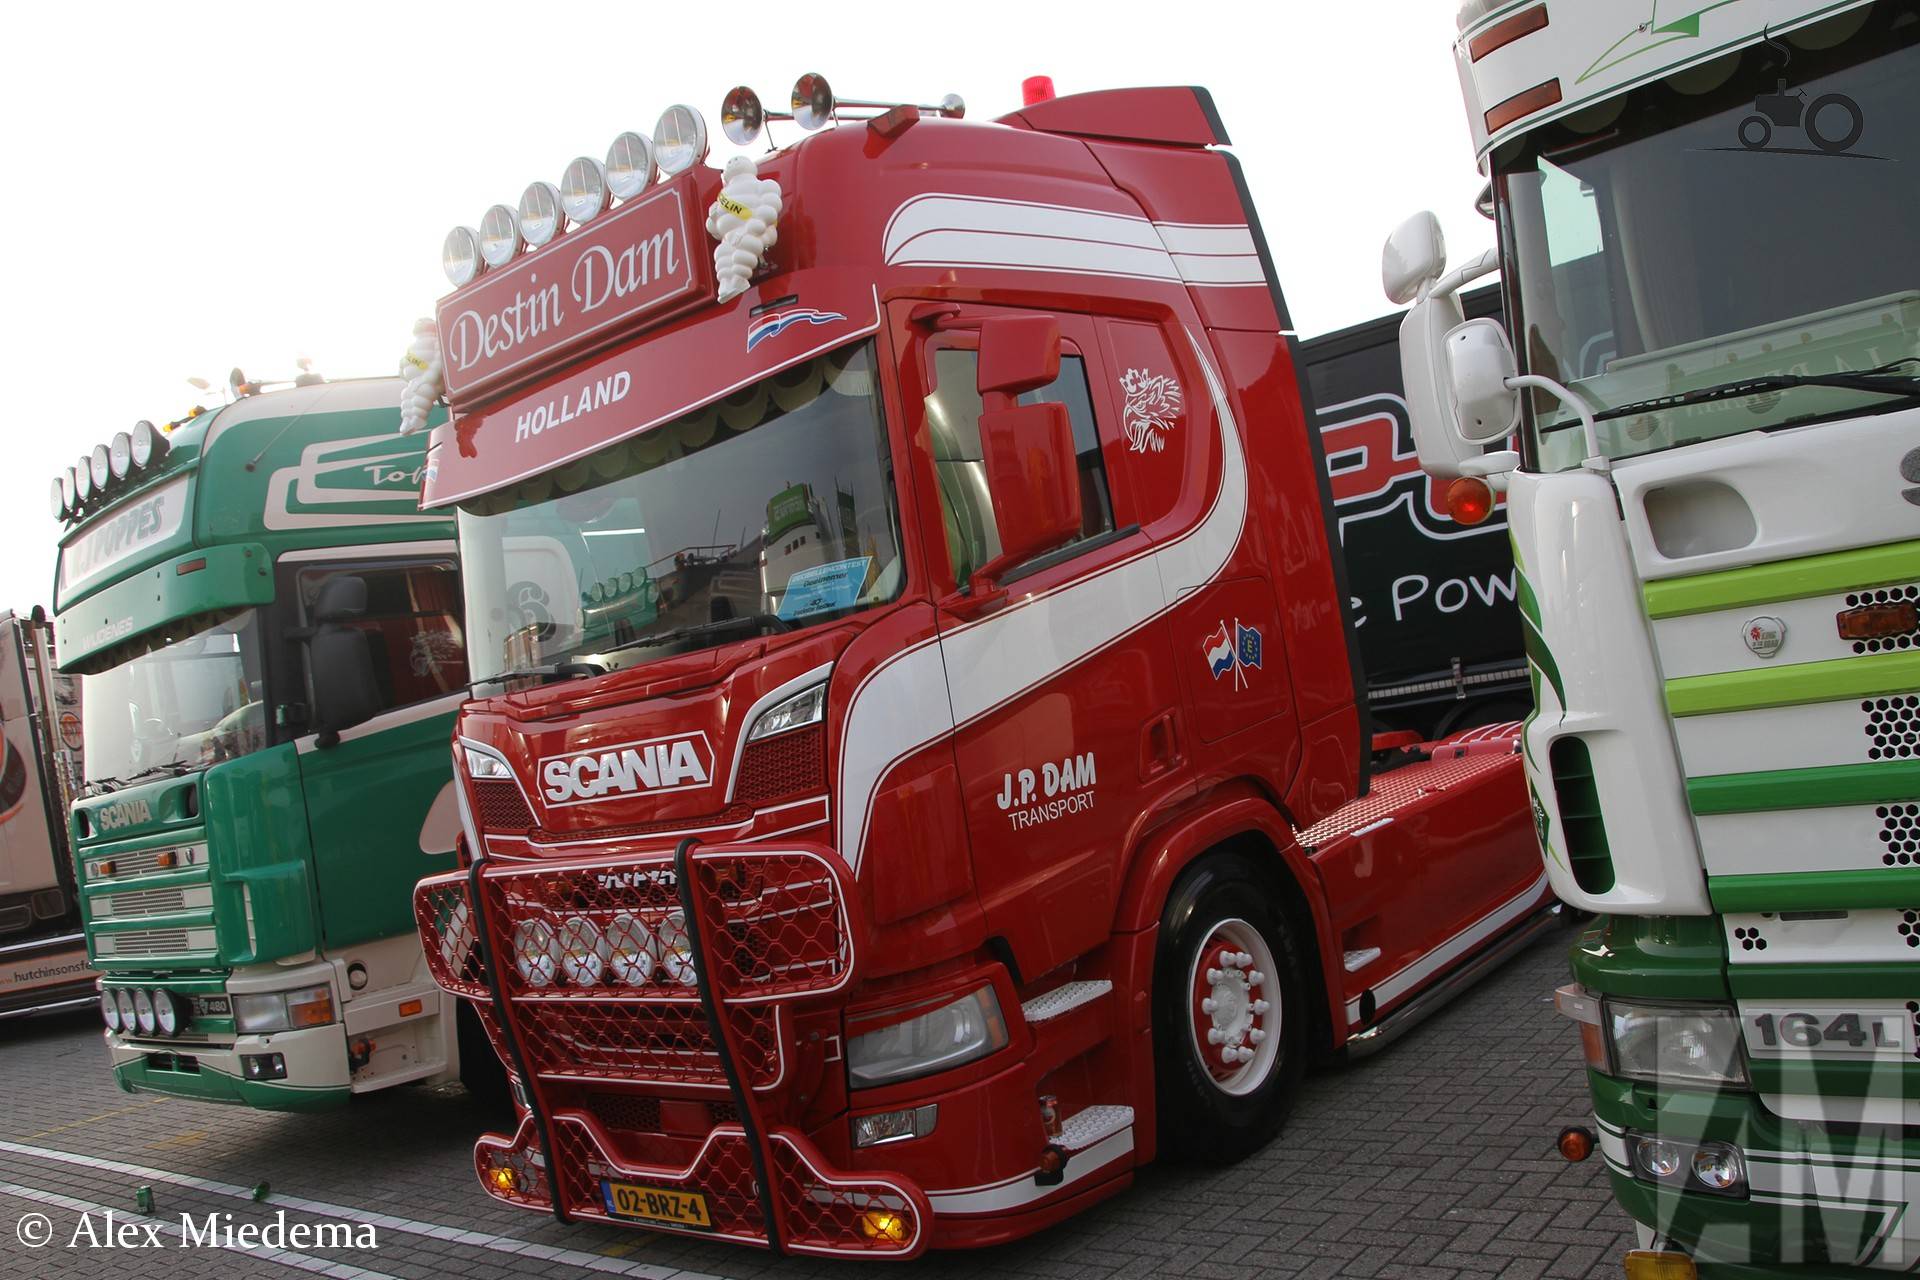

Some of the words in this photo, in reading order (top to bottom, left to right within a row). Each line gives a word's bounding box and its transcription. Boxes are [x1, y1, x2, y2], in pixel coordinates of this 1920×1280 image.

[450, 273, 564, 372] Destin
[571, 228, 680, 313] Dam
[514, 370, 631, 443] HOLLAND
[543, 739, 709, 802] SCANIA
[997, 773, 1037, 810] J.P.
[1042, 752, 1097, 797] DAM
[100, 799, 153, 831] SCANIA
[1008, 790, 1095, 831] TRANSPORT
[209, 1000, 227, 1012] 480
[617, 1188, 702, 1222] 02-BRZ-4
